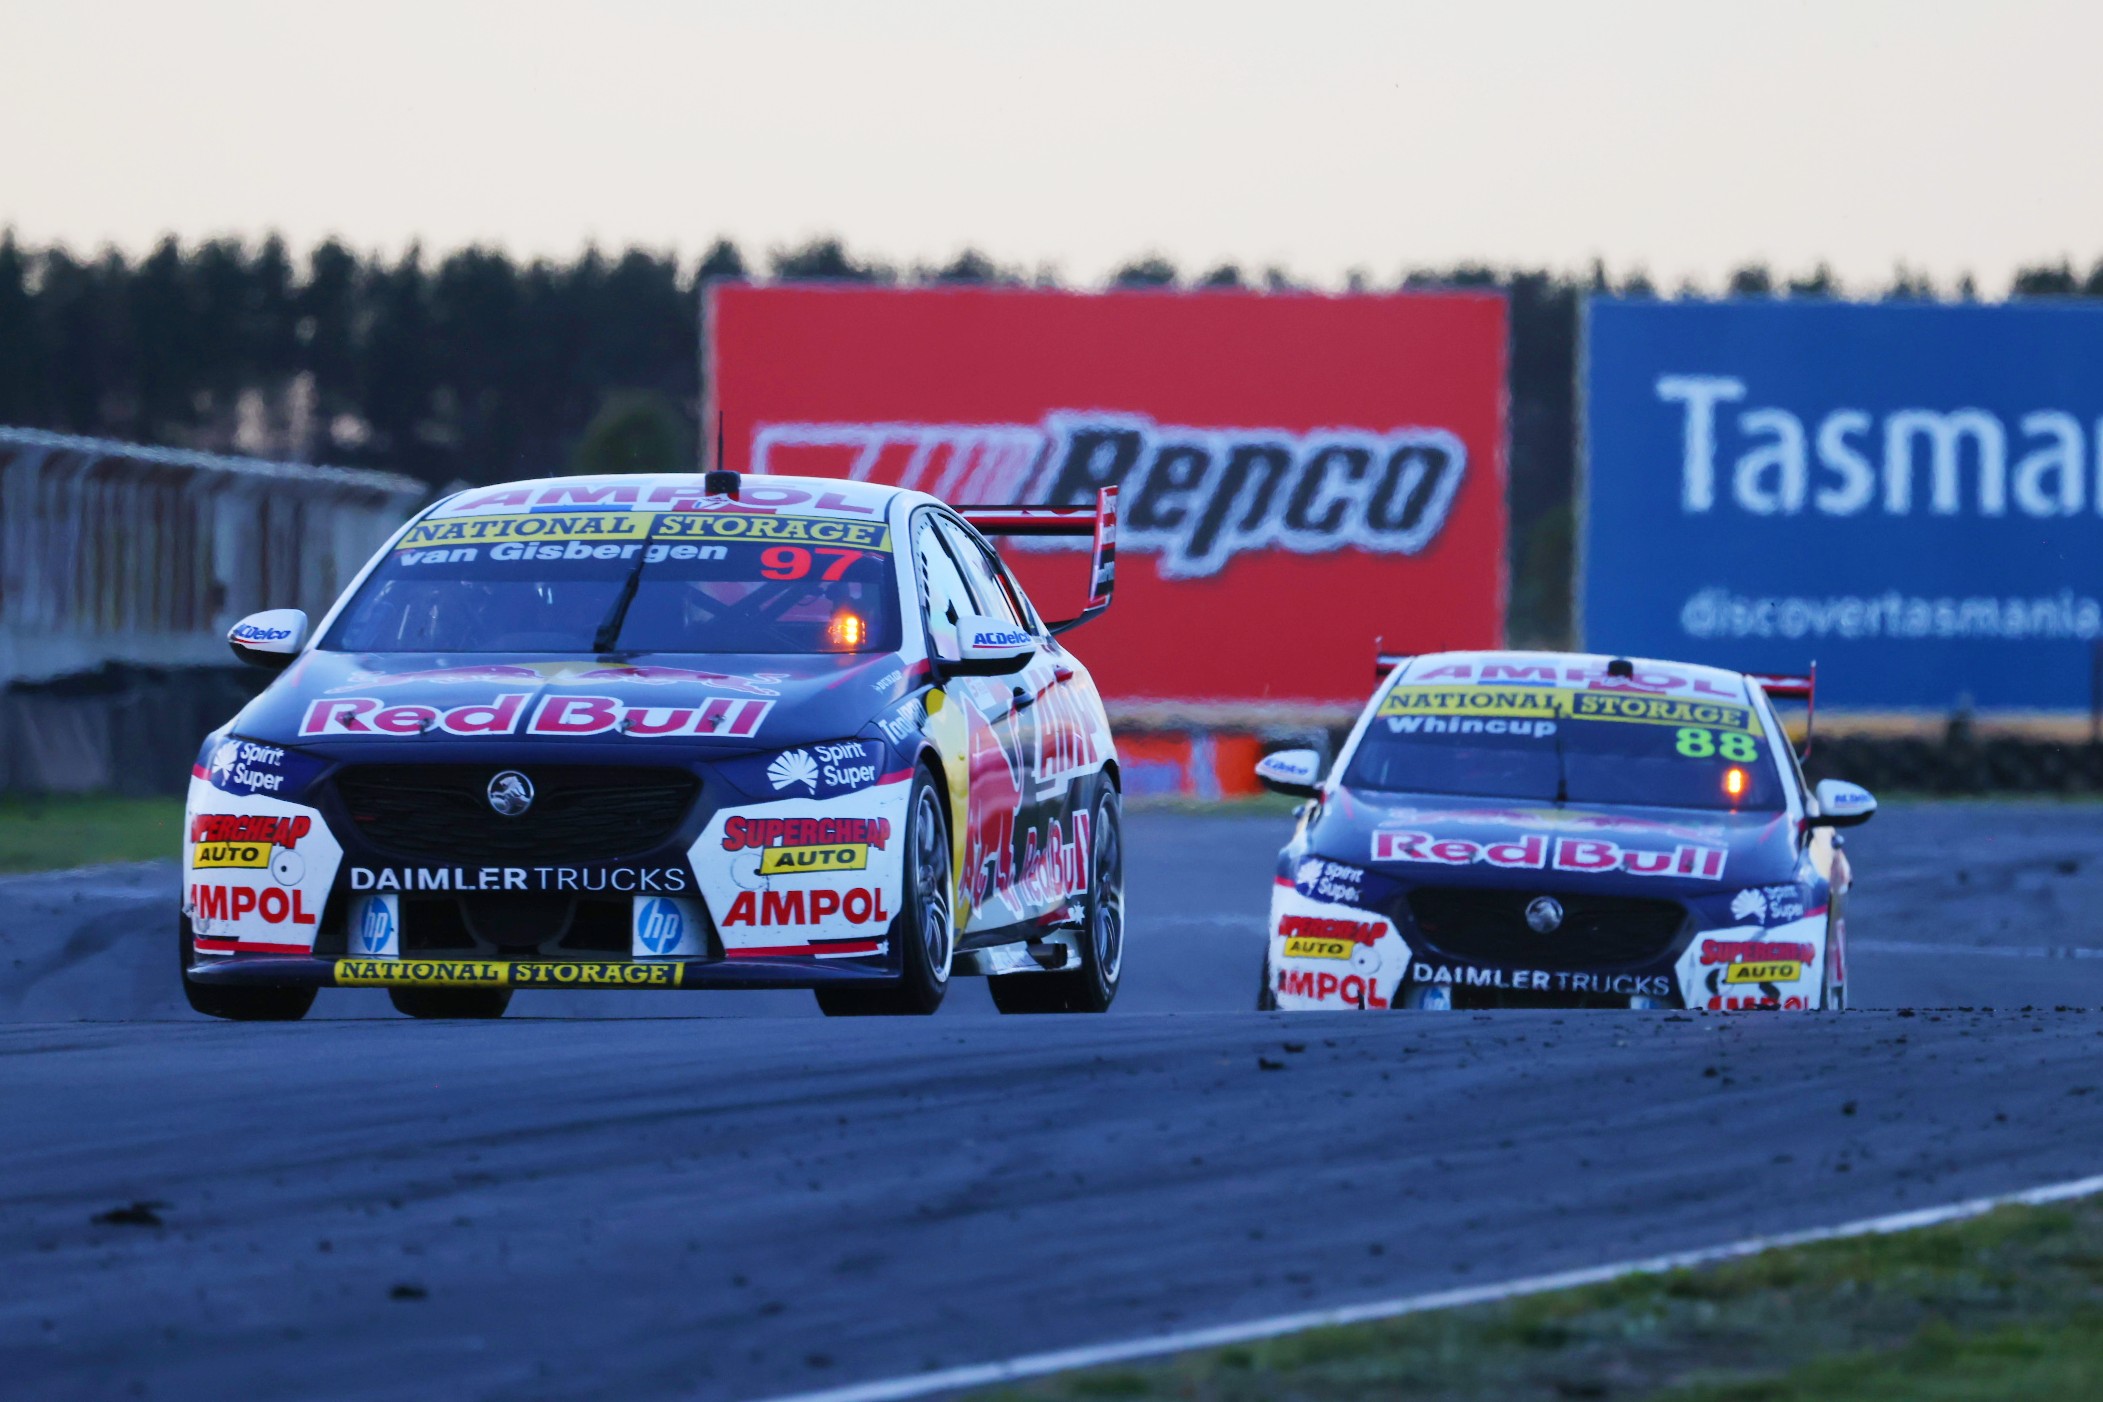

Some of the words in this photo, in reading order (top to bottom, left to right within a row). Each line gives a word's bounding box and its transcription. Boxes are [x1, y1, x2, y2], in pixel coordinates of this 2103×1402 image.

[1657, 375, 2103, 516] Tasma
[456, 485, 875, 514] AMPOL
[1038, 414, 1460, 568] Repco
[404, 514, 636, 544] NATIONAL
[658, 514, 876, 545] STORAGE
[400, 547, 478, 568] van
[489, 541, 728, 567] Gisbergen
[760, 546, 864, 582] 97
[974, 631, 1031, 645] ACDelco
[1417, 664, 1739, 700] AMPOL
[299, 694, 532, 736] Red
[528, 694, 772, 738] Bull
[1386, 692, 1564, 711] NATIONAL
[1580, 694, 1741, 726] STORAGE
[1387, 715, 1557, 738] Whincup
[239, 742, 286, 767] Spirit
[816, 742, 867, 764] Spirit
[1675, 727, 1758, 763] 88
[232, 764, 284, 793] Super
[823, 764, 877, 788] Super
[191, 813, 312, 851] PERCHEAP
[721, 815, 891, 852] SUPERCHEAP
[199, 846, 260, 863] AUTO
[773, 848, 857, 868] AUTO
[1373, 830, 1548, 869] Red
[1552, 836, 1728, 881] Bull
[351, 867, 527, 890] DAIMLER
[534, 867, 687, 891] TRUCKS
[721, 886, 888, 927] AMPOL
[1770, 901, 1804, 921] Supe
[363, 899, 390, 952] hp
[642, 900, 682, 952] hp
[1289, 941, 1344, 956] AUTO
[341, 961, 500, 982] NATIONAL
[514, 962, 670, 985] STORAGE
[1413, 962, 1550, 991] DAIMLER
[1554, 972, 1670, 996] TRUCKS
[1735, 965, 1795, 979] AUTO
